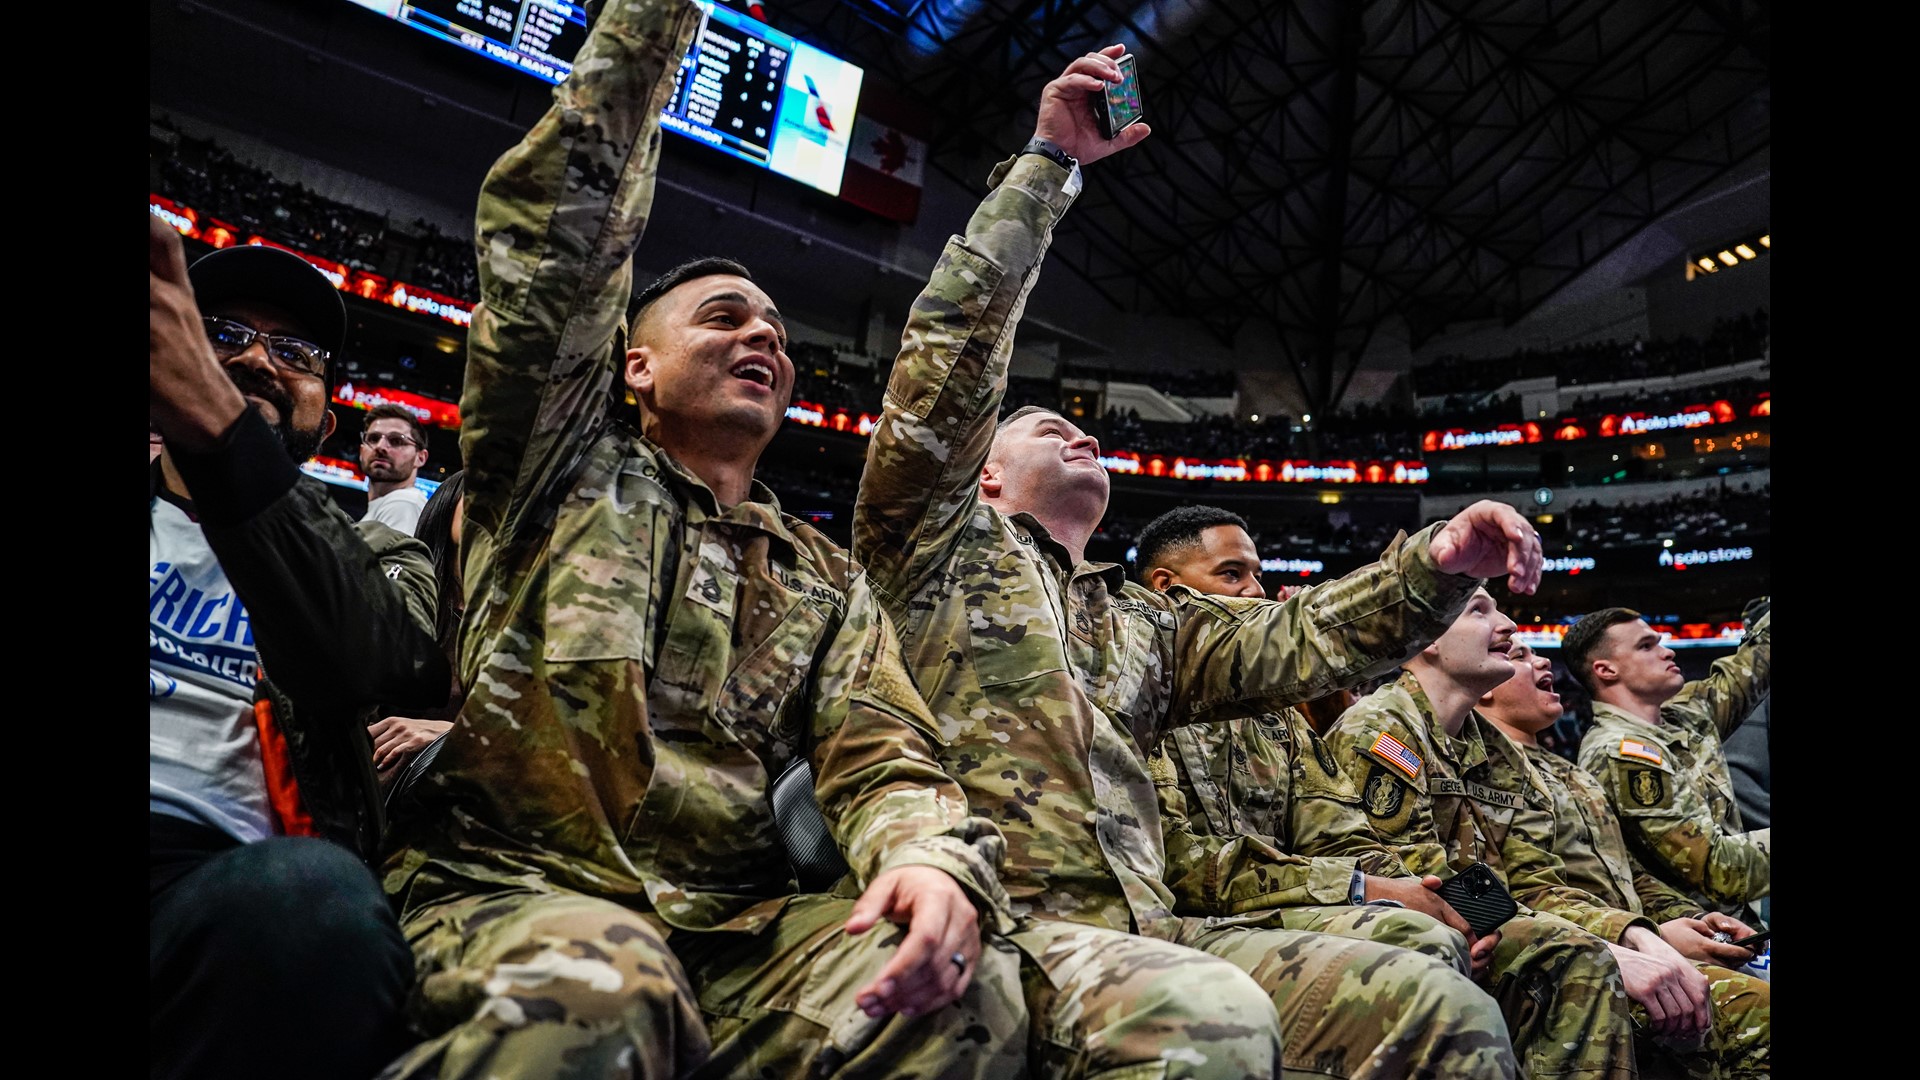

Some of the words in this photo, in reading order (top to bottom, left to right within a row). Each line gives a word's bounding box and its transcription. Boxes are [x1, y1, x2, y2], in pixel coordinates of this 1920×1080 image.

[460, 32, 485, 50] GET
[486, 42, 519, 64] YOUR
[520, 56, 554, 79] MAVS
[406, 294, 440, 315] solo
[438, 303, 473, 324] stov
[1636, 415, 1669, 431] solo
[1668, 410, 1711, 429] stove
[1289, 558, 1324, 573] stove
[1554, 556, 1596, 571] stove
[1673, 550, 1708, 566] solo
[1707, 546, 1753, 564] stove
[1472, 784, 1487, 800] U.S.
[1487, 791, 1516, 806] ARMY
